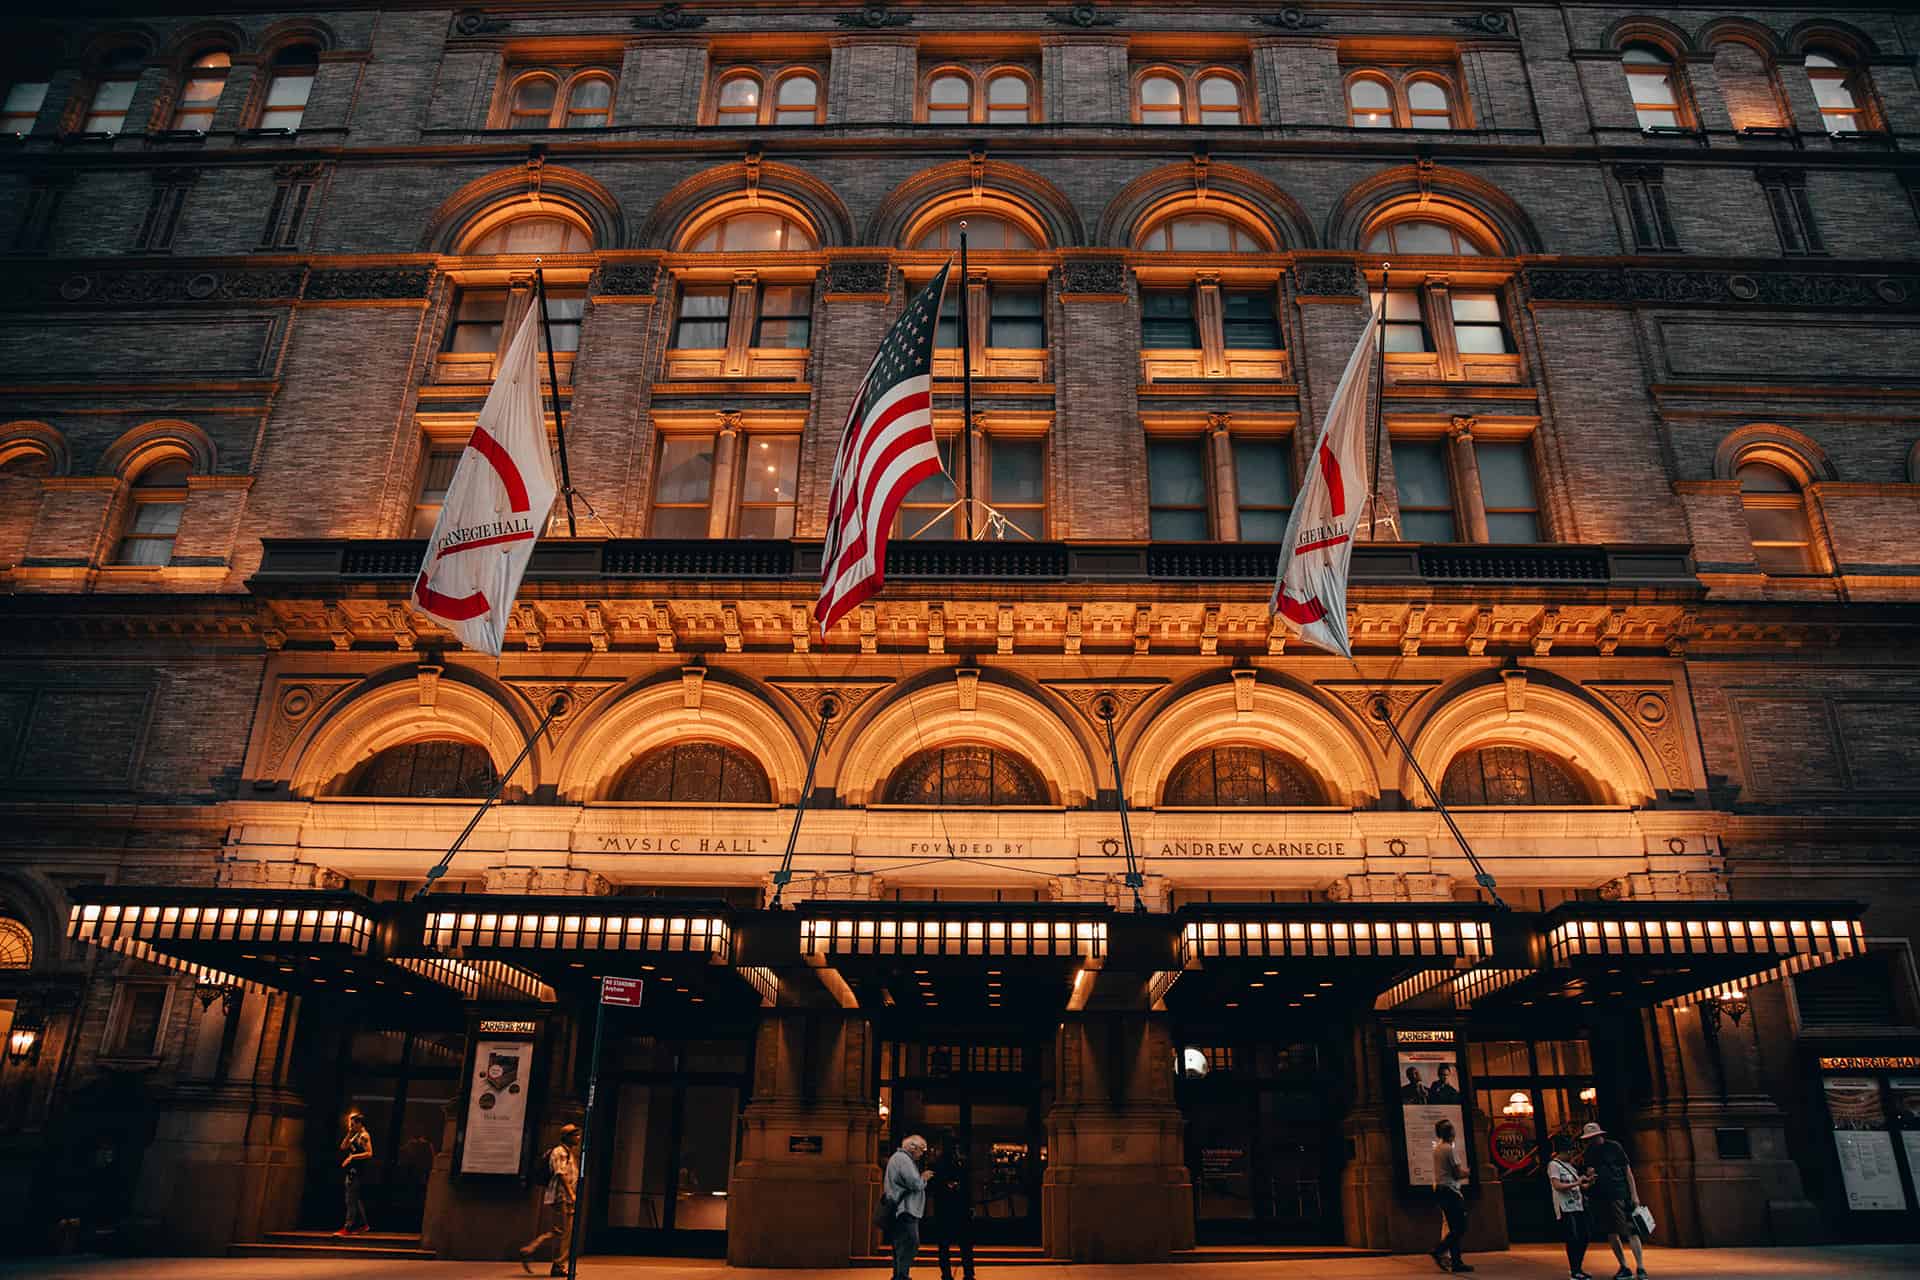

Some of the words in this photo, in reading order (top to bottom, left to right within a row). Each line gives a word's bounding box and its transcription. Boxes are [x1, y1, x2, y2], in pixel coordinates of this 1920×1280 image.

[492, 518, 534, 535] HALL
[602, 837, 681, 852] MVSIC
[700, 839, 757, 853] HALL
[1004, 843, 1024, 854] BY
[1160, 842, 1244, 857] ANDREW
[1251, 842, 1345, 857] CARNEGIE
[1830, 1057, 1889, 1069] CARNEGIE
[1895, 1057, 1920, 1069] HAL
